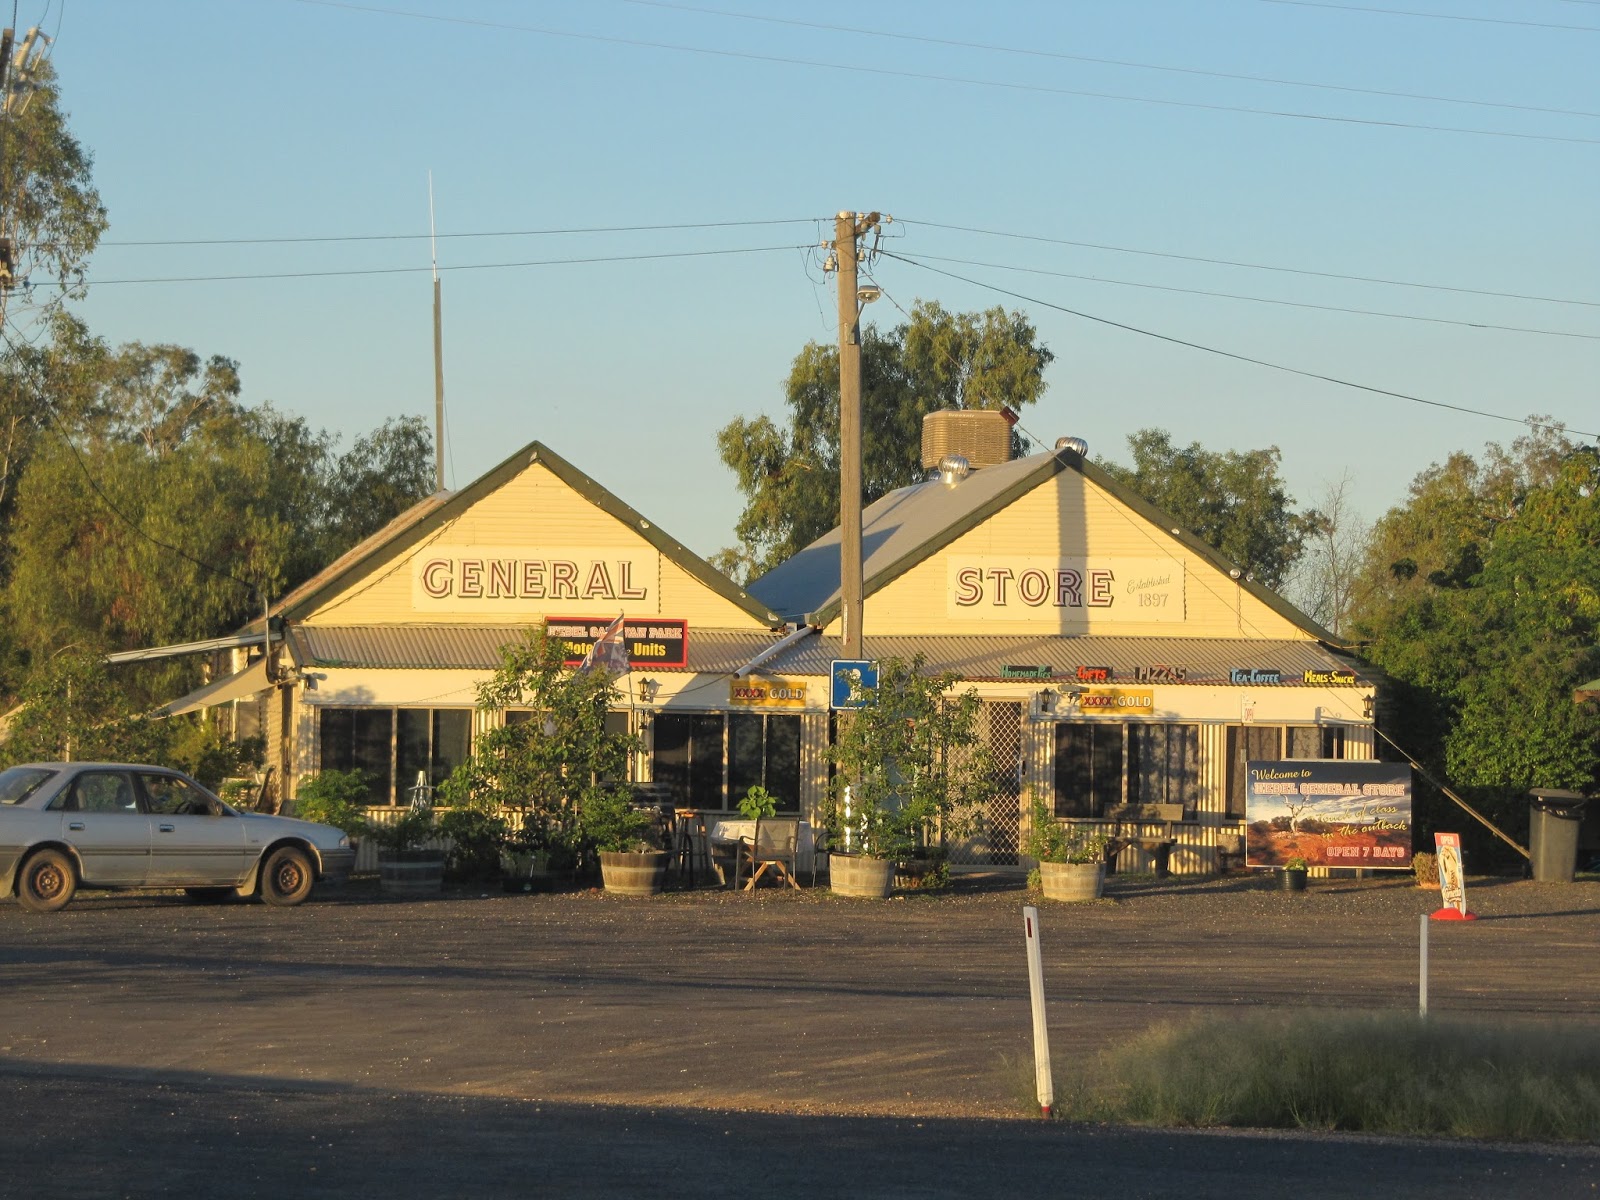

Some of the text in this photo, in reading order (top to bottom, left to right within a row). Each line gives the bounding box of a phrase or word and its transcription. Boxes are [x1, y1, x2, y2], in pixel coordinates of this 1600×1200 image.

[420, 558, 647, 600] GENERAL
[1127, 574, 1170, 594] Established
[955, 567, 1115, 607] STORE
[1139, 593, 1168, 607] 1897
[649, 627, 683, 639] PARK
[633, 642, 666, 656] Units
[1139, 667, 1186, 680] PIZZAS
[734, 687, 804, 699] XXXX GOLD
[1083, 695, 1151, 708] XXXX GOLD
[1252, 769, 1312, 781] Welcome to
[1300, 782, 1360, 796] GENERAL
[1363, 783, 1405, 797] STORE
[1337, 824, 1358, 836] the
[1361, 819, 1407, 833] outback
[1327, 846, 1405, 858] OPEN 7 DAYS
